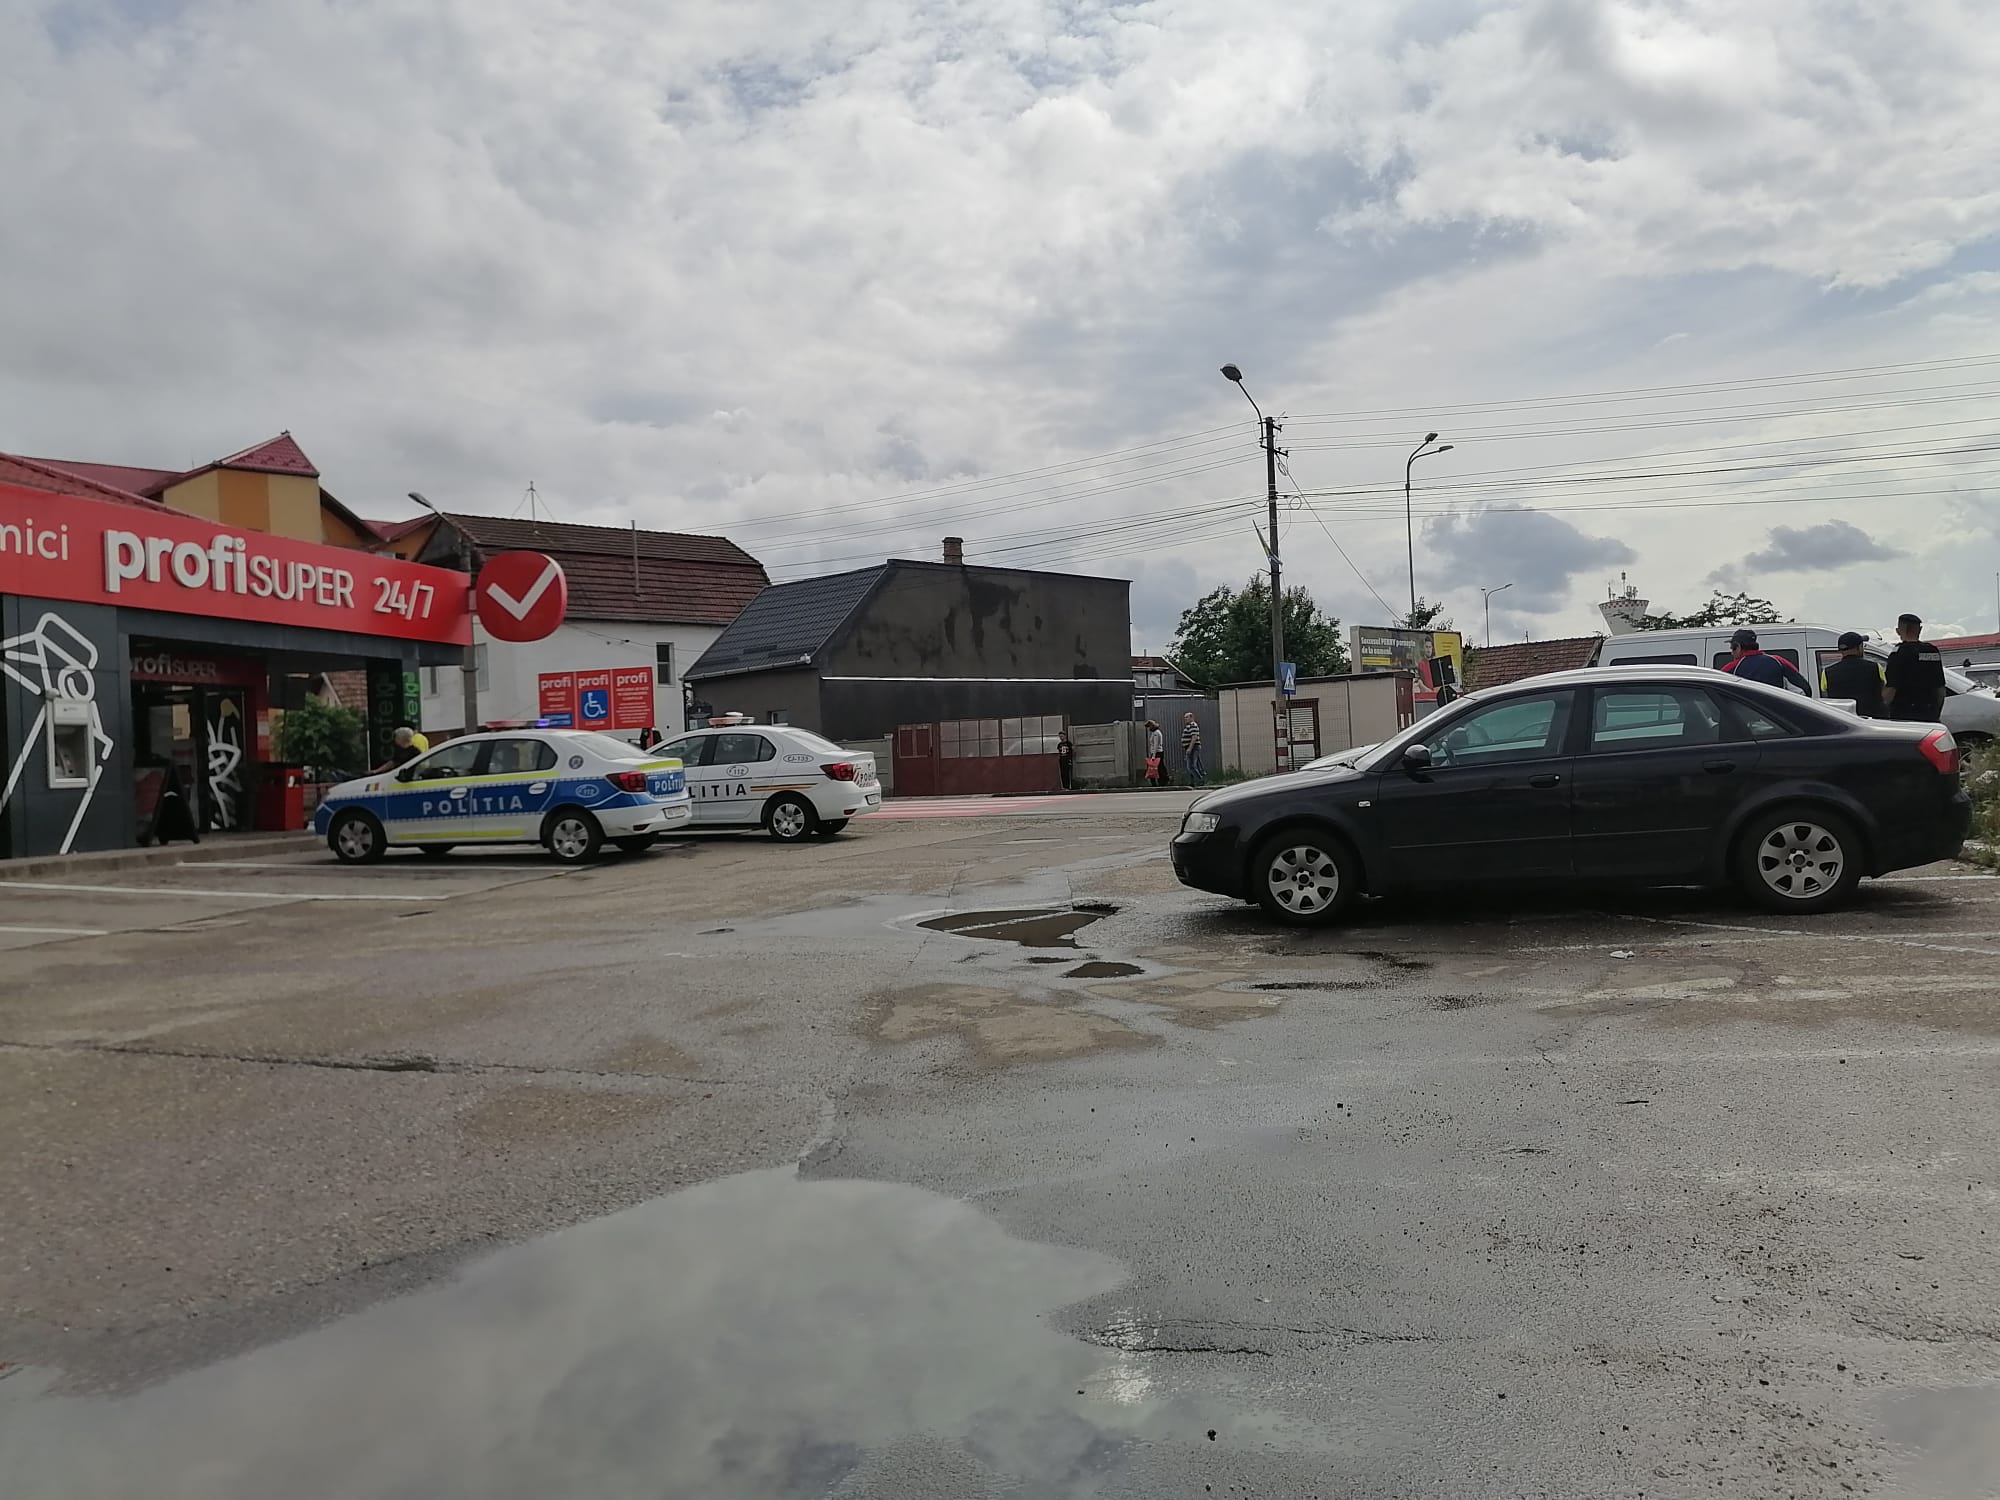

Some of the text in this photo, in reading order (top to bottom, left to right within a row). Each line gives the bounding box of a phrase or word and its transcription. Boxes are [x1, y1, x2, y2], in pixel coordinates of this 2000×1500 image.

[373, 577, 434, 620] 24/7
[130, 654, 171, 675] rofi
[541, 676, 571, 691] profi
[578, 674, 608, 689] profi
[617, 672, 648, 687] profi
[688, 783, 746, 799] LITIA
[422, 795, 524, 816] POLITIA
